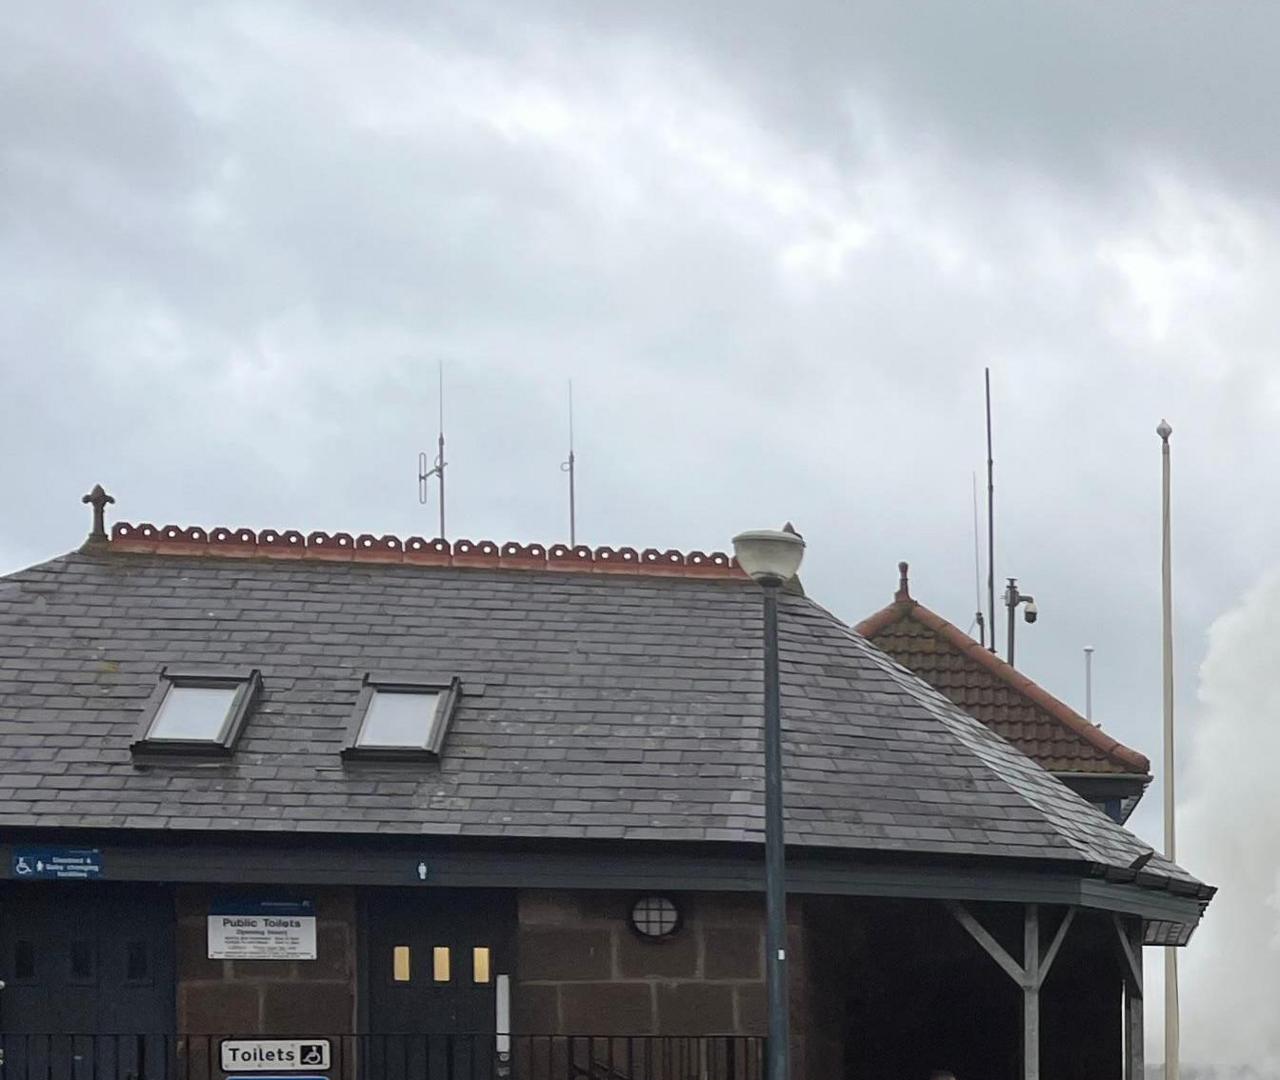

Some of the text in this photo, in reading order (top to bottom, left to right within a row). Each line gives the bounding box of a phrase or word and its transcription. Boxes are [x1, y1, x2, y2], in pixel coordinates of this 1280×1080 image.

[223, 918, 302, 928] Public Toilets
[228, 1047, 295, 1062] Toilets
